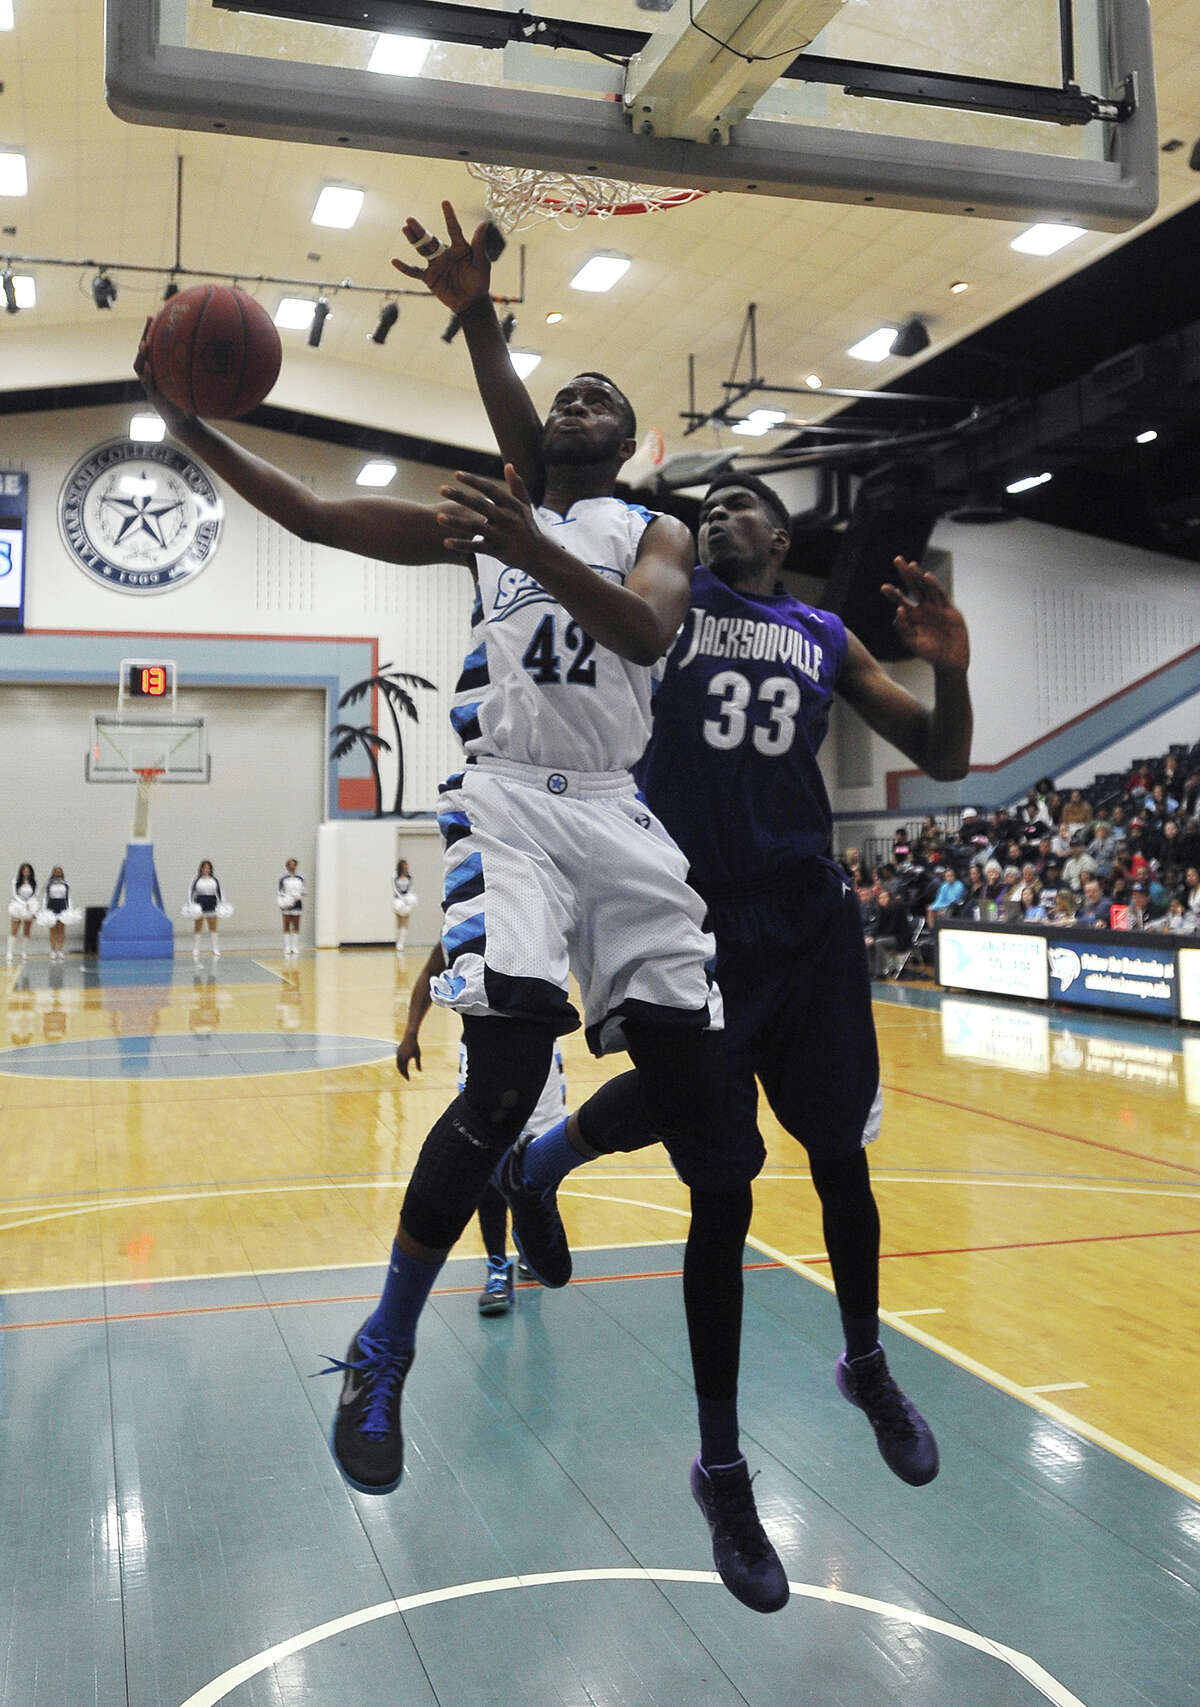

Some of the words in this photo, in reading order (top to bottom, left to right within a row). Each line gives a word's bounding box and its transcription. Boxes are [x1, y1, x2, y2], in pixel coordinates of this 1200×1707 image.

[97, 443, 171, 467] COLLEGE
[141, 666, 166, 695] 13
[521, 613, 597, 688] 42
[679, 607, 823, 684] JACKSONVILLE
[703, 670, 802, 757] 33
